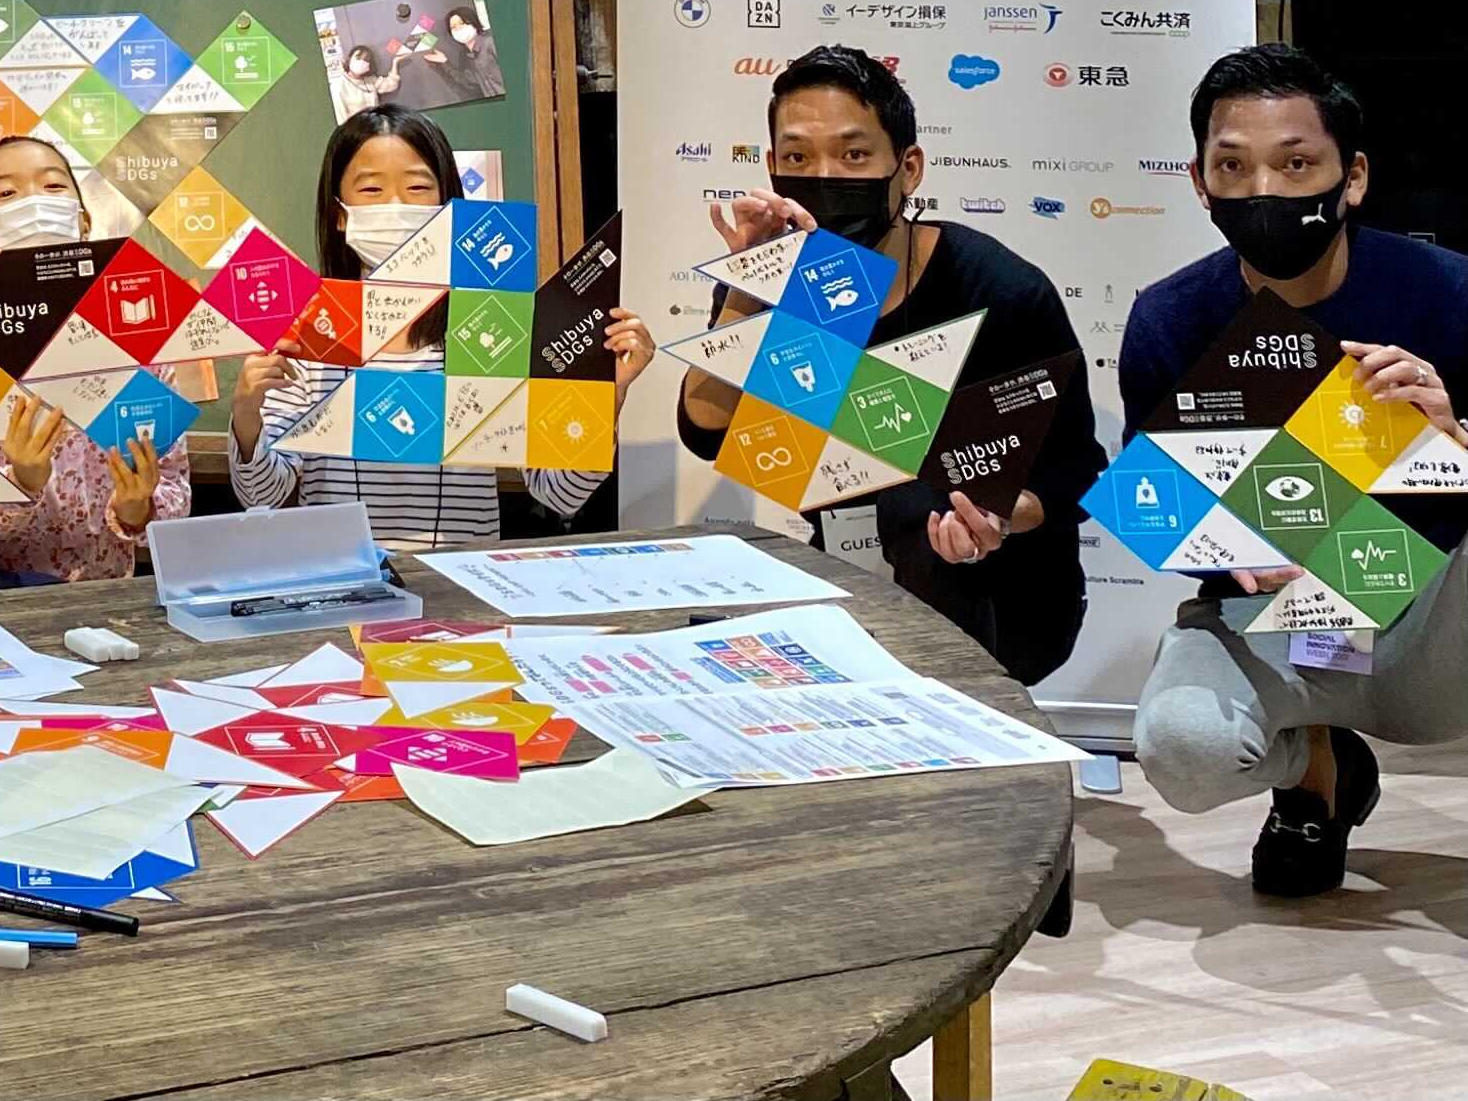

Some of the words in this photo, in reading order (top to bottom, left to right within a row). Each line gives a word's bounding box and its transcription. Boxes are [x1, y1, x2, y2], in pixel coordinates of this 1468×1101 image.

[845, 4, 947, 19] イーデザイン損保
[1100, 11, 1191, 29] こくみん共済
[734, 57, 782, 75] au
[1078, 65, 1130, 87] 東急
[916, 124, 952, 135] artner
[675, 142, 712, 157] Asahi
[732, 153, 760, 164] KIND
[1032, 158, 1066, 171] mixi
[1068, 161, 1114, 173] GROUP
[1139, 159, 1189, 172] MIZUHO
[960, 197, 1005, 213] twitch
[1034, 201, 1062, 212] VOX
[804, 268, 818, 283] 14
[541, 307, 605, 363] Shibuya
[1256, 333, 1316, 351] SDGs
[552, 333, 594, 373] SDGs
[1228, 351, 1318, 369] Shibuya
[940, 433, 1022, 470] Shibuya
[947, 458, 1002, 485] SDGs
[841, 537, 883, 551] GUES
